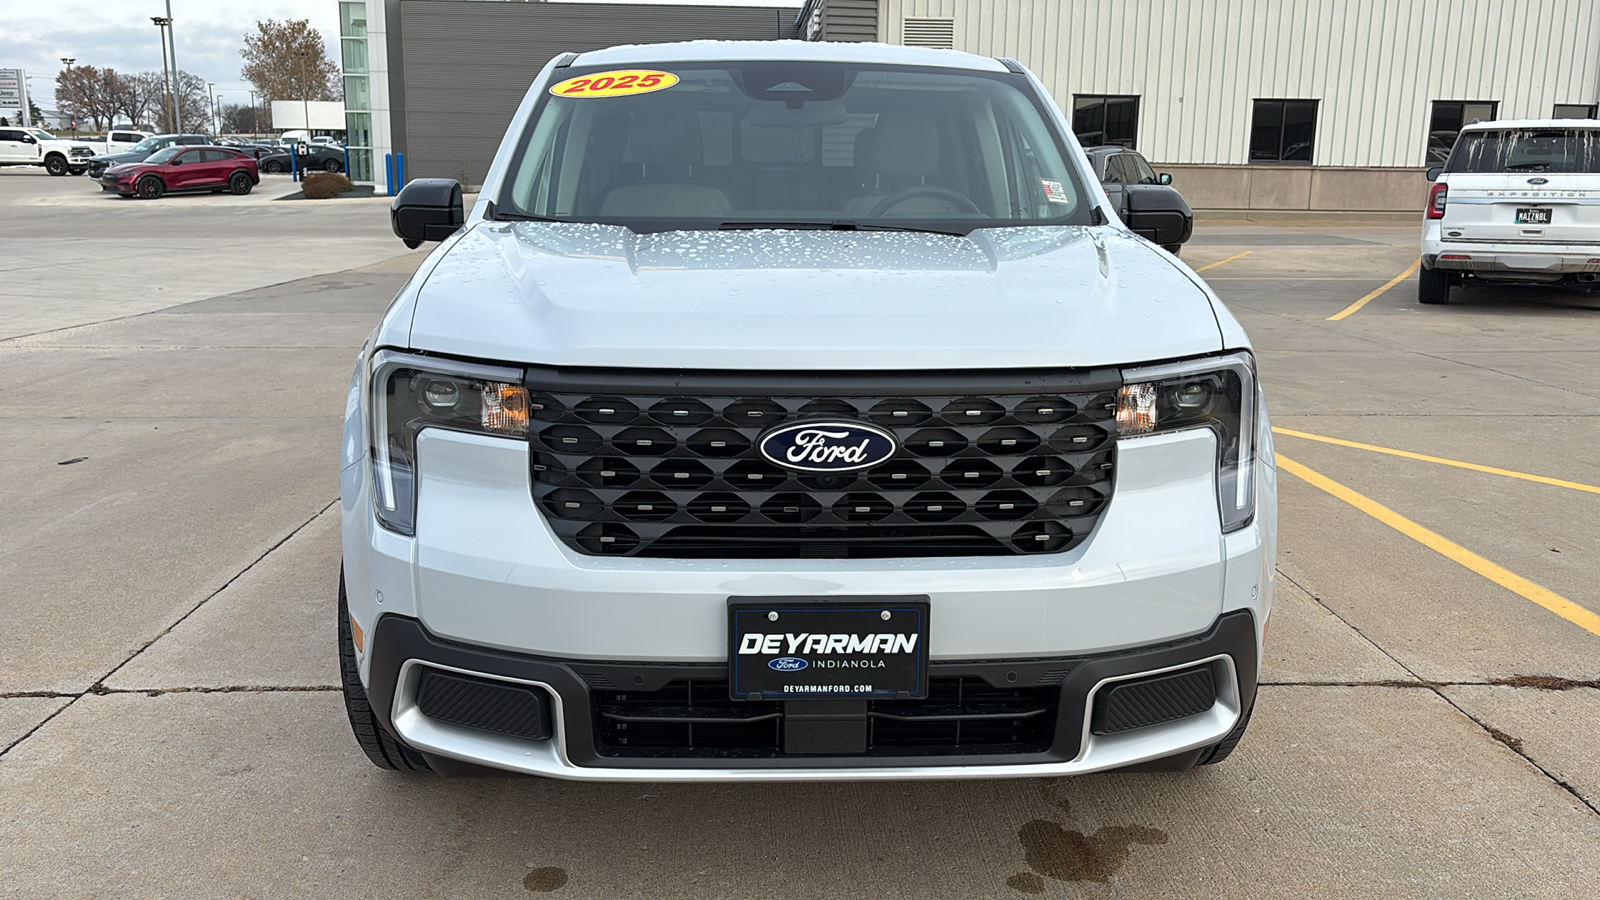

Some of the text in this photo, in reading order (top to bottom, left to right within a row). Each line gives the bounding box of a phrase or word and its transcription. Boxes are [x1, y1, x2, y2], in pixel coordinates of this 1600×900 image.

[562, 73, 666, 94] 2025
[786, 429, 870, 463] Ford
[738, 633, 918, 655] DEYARMAN
[775, 658, 886, 670] Ford INDIANOLA
[783, 684, 873, 693] DEYARMANFORD.COM
